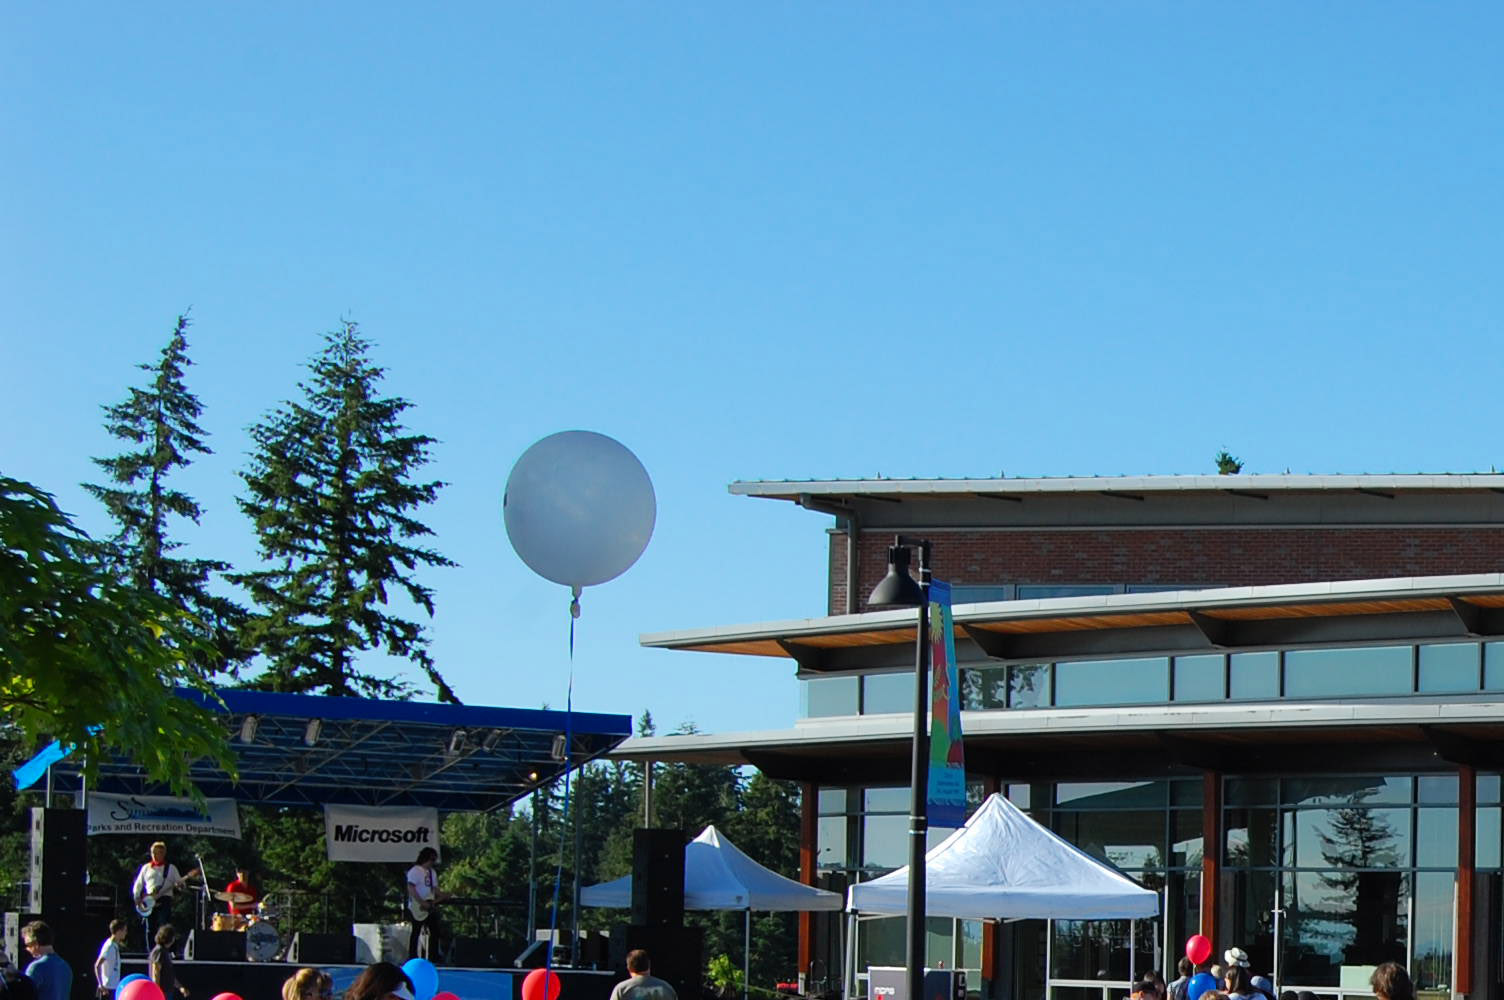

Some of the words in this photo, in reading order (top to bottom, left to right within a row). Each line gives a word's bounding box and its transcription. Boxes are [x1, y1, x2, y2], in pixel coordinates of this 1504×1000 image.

[115, 823, 132, 832] and
[135, 822, 184, 832] Recreation
[334, 824, 429, 843] Microsoft
